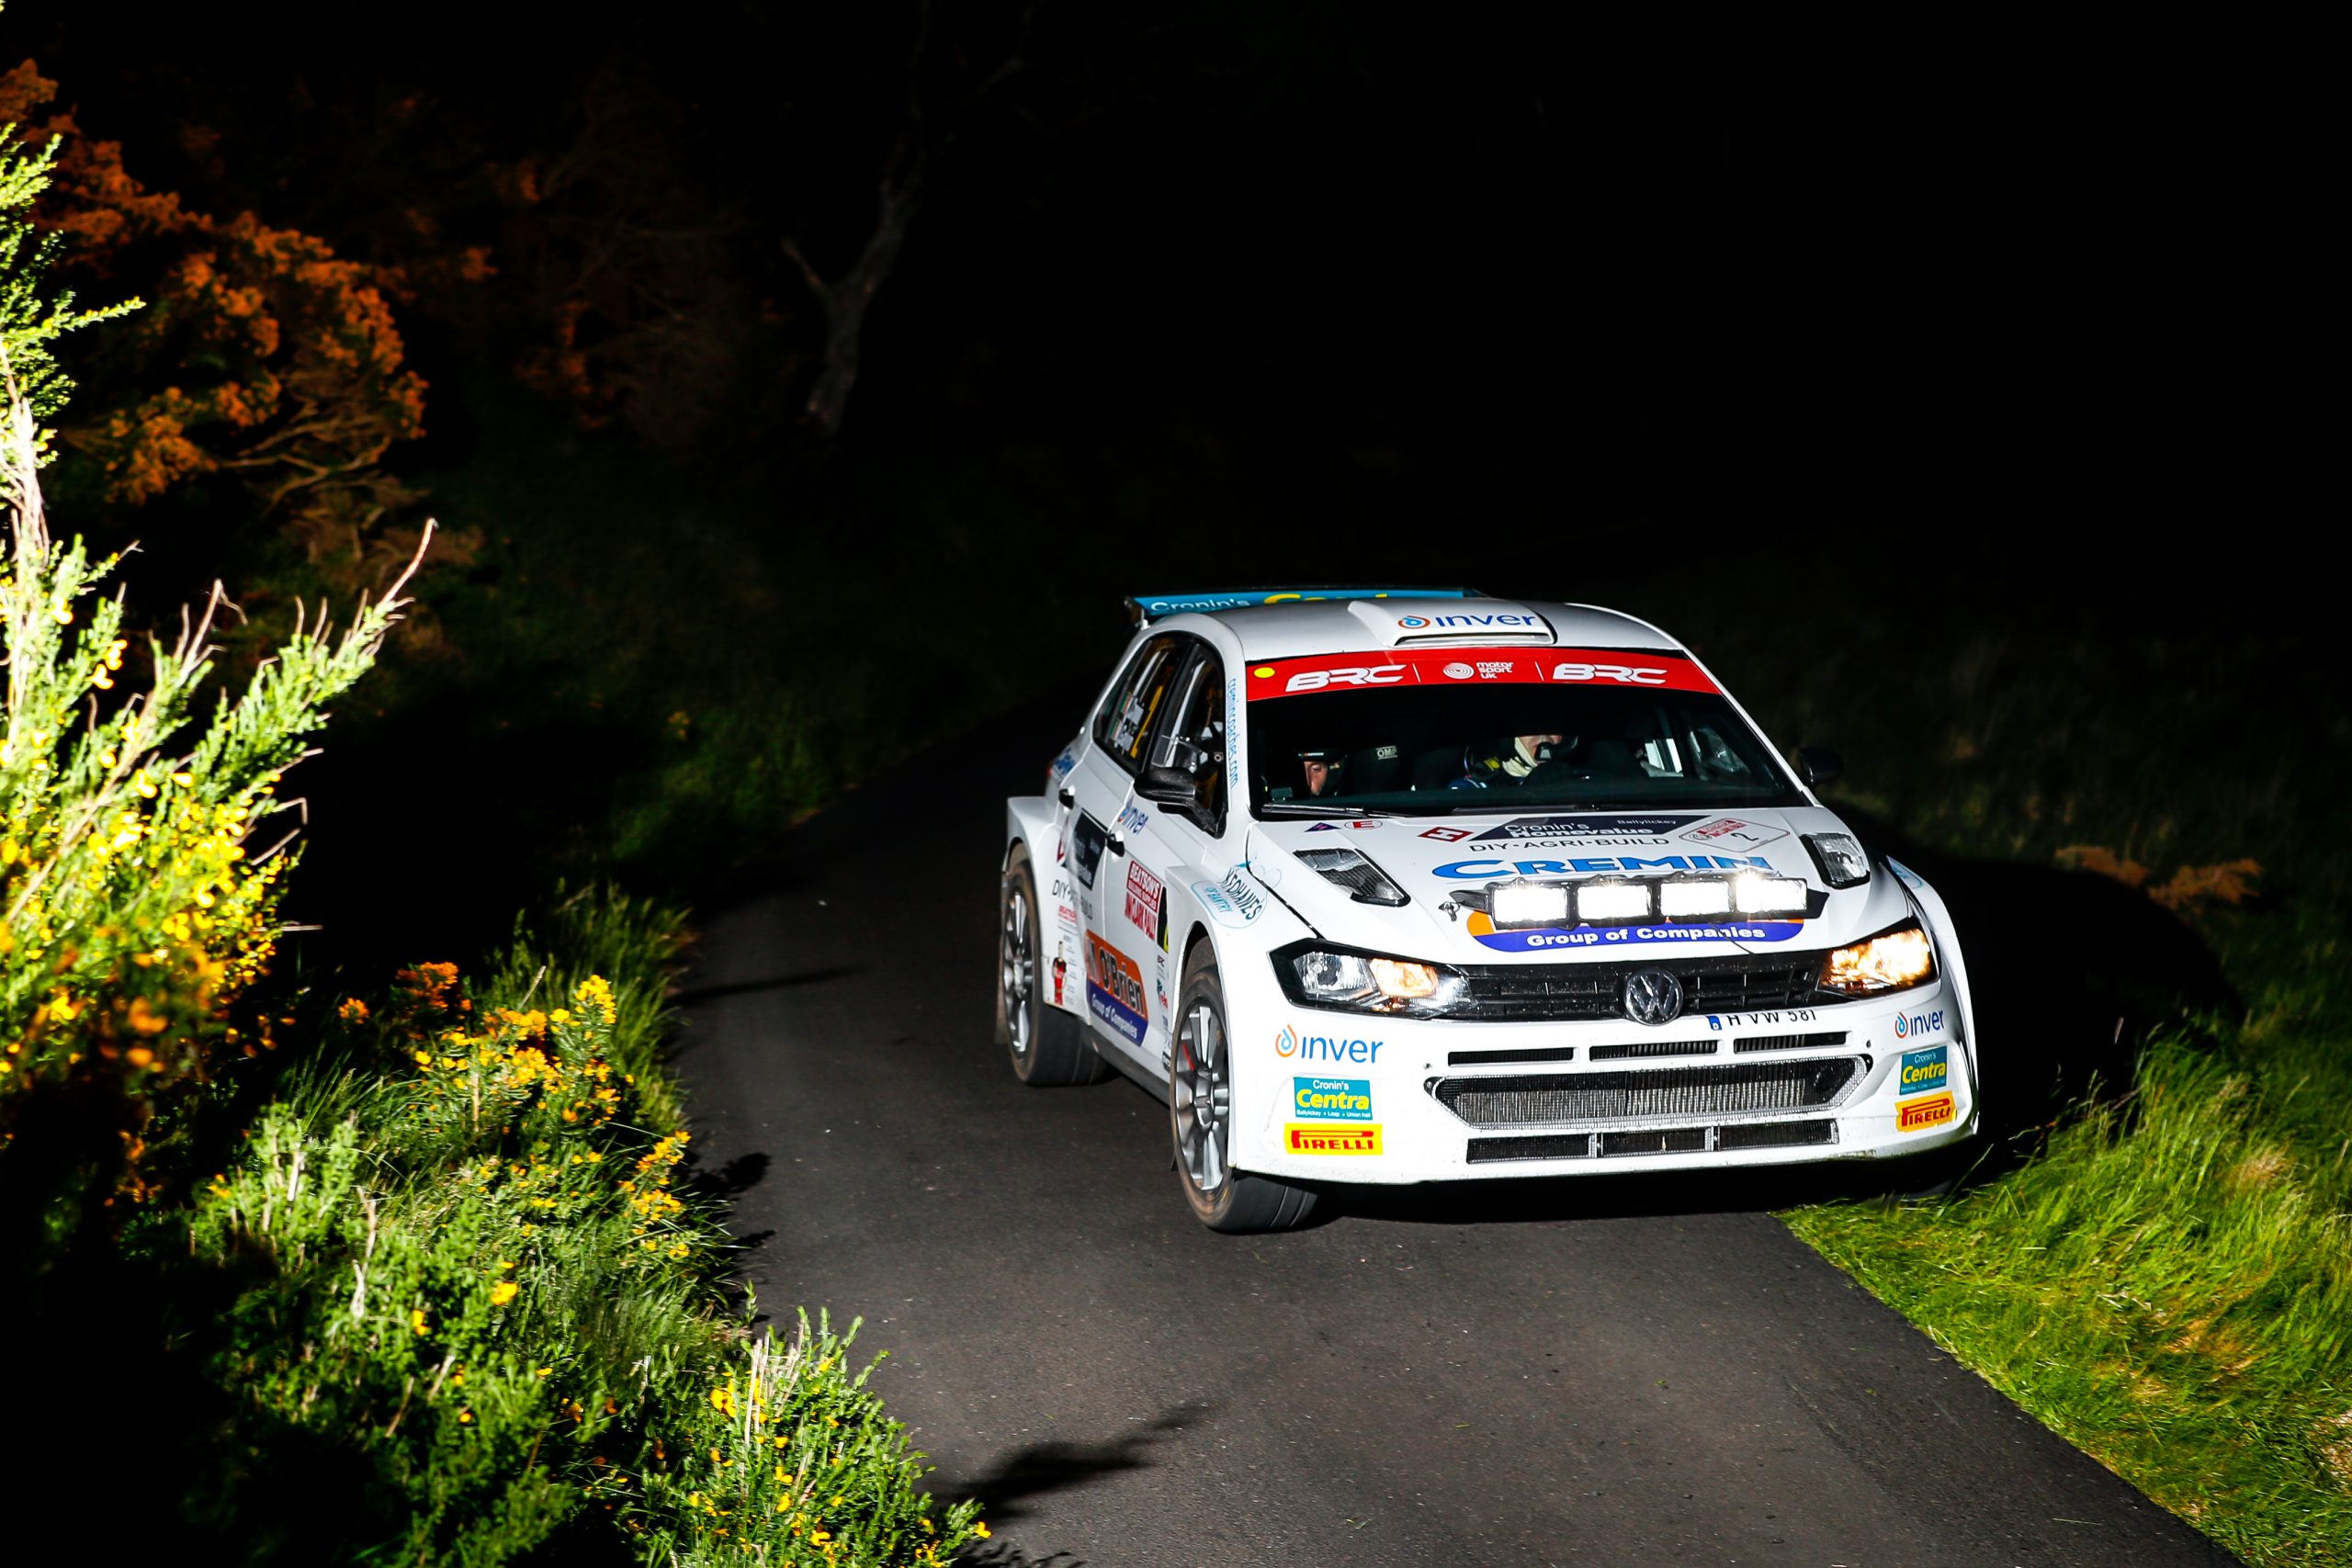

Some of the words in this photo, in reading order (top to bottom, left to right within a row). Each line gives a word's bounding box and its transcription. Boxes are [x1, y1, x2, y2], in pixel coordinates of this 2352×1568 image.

[1434, 615, 1536, 626] inver
[1285, 664, 1407, 692] BRC
[1553, 663, 1668, 684] BRC
[1377, 748, 1397, 758] OMP
[1504, 822, 1589, 831] Cronin's
[1510, 828, 1653, 838] Homevalue
[1431, 855, 1774, 878] CREMIN
[1527, 932, 1598, 947] Group
[1606, 930, 1629, 942] of
[1632, 925, 1766, 942] Companies
[1910, 1010, 1945, 1036] inver
[1301, 1036, 1384, 1064] inver
[1915, 1051, 1937, 1064] Cronin's
[1902, 1062, 1946, 1084] Centra
[1312, 1079, 1350, 1090] Cronin's
[1296, 1089, 1369, 1110] Centra
[1902, 1098, 1951, 1127] PIRELLI
[1291, 1130, 1374, 1149] PIRELLI
